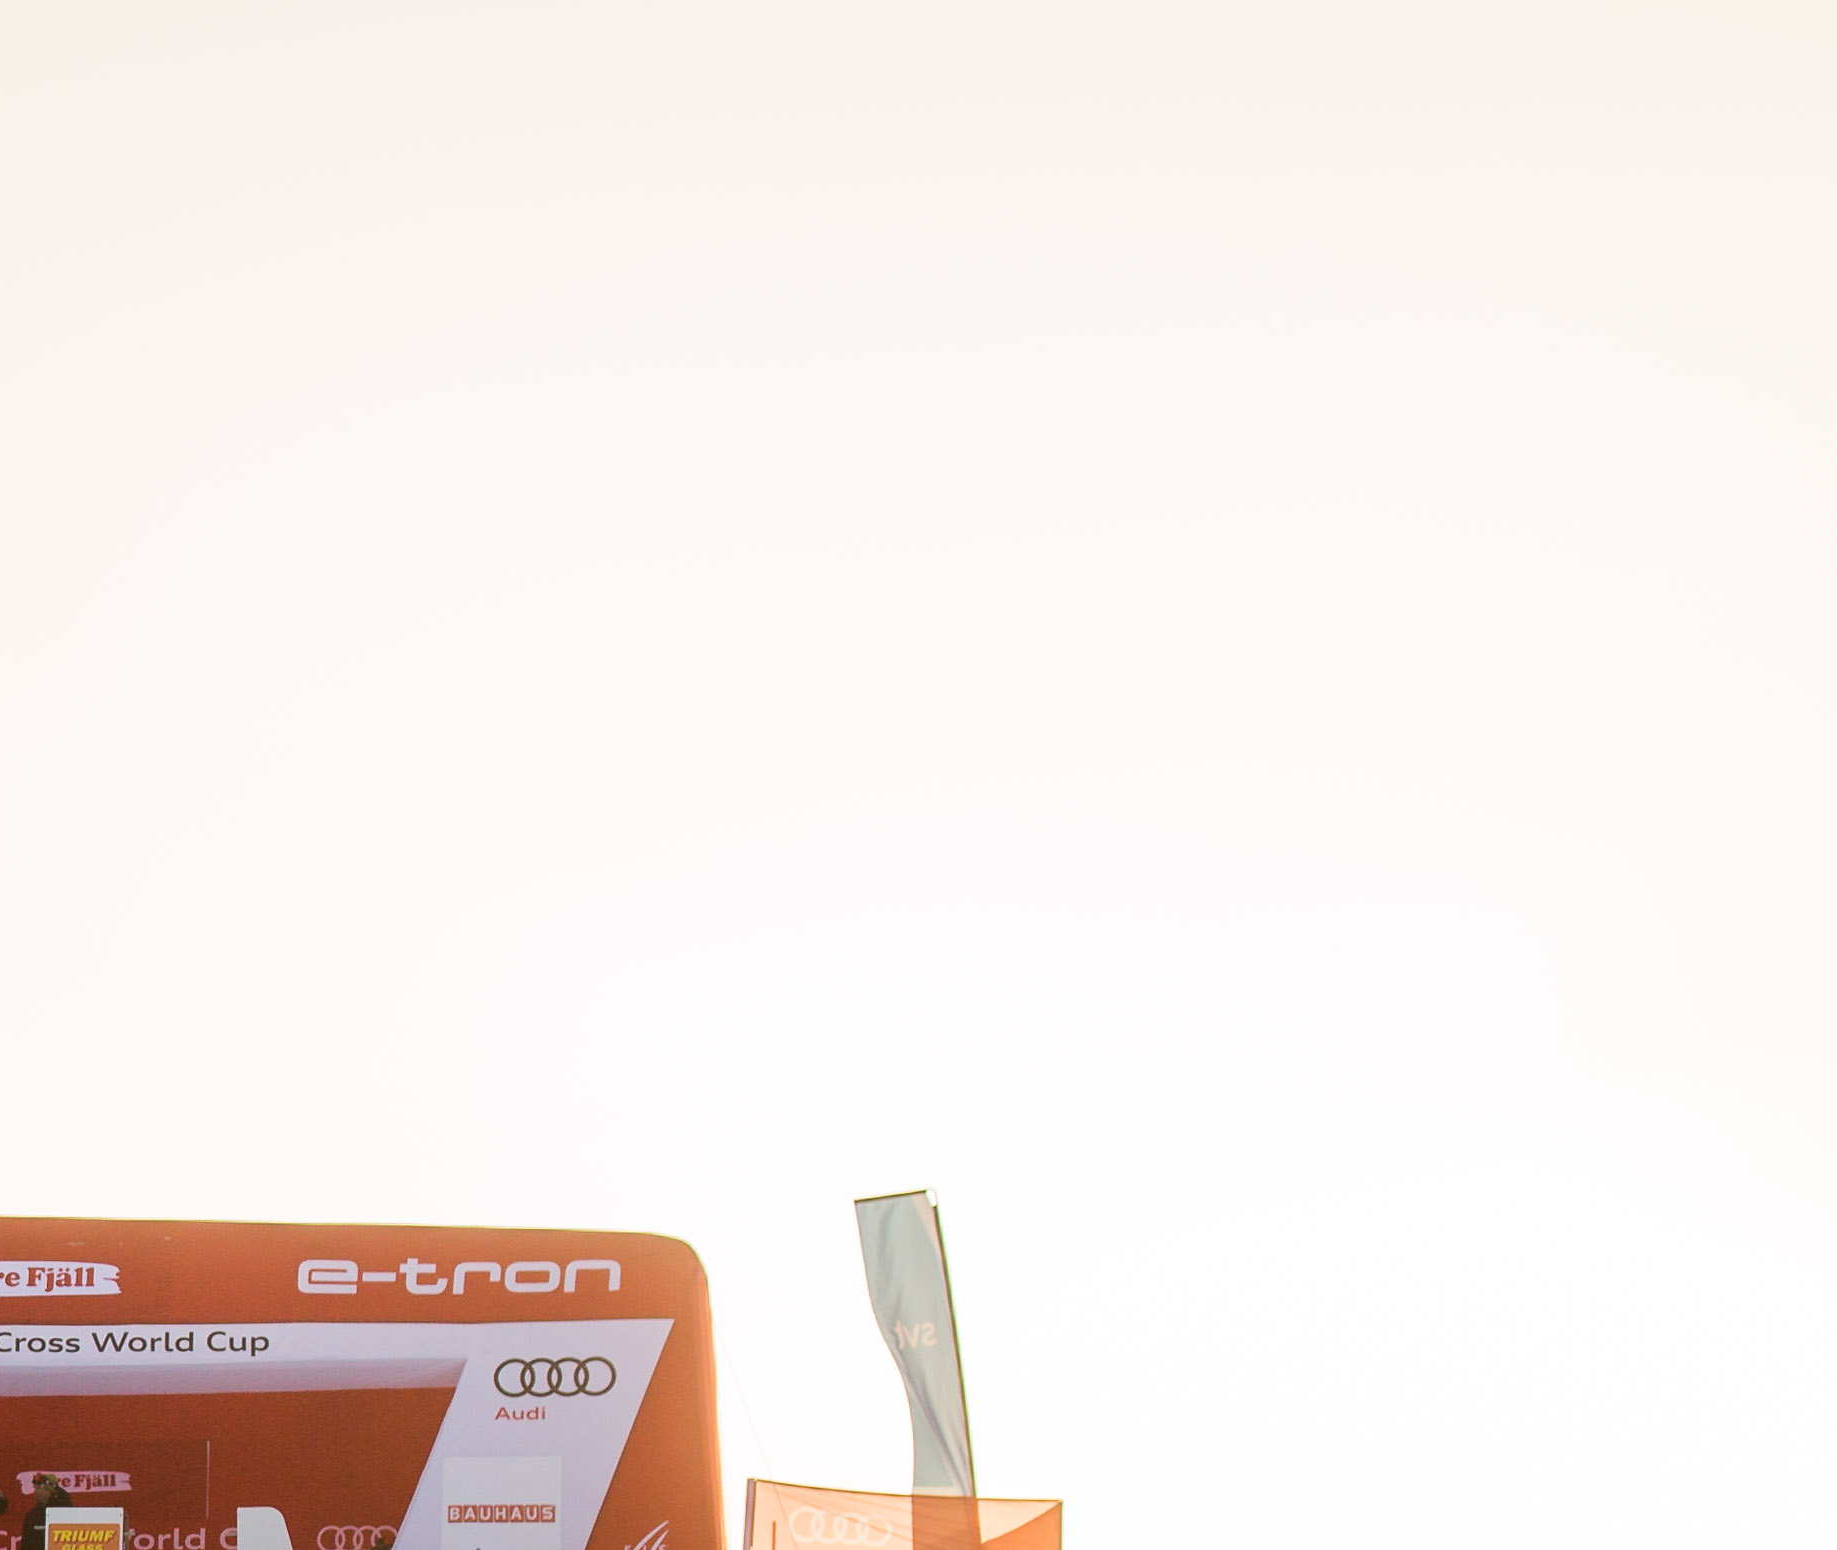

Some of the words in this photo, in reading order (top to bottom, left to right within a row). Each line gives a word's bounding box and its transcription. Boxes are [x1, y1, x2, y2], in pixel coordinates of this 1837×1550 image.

[26, 1266, 95, 1293] Fjäll
[297, 1257, 622, 1295] e-tron
[91, 1331, 195, 1353] World
[206, 1330, 270, 1357] Cup
[494, 1405, 547, 1421] Audi
[74, 1474, 116, 1490] Fjäll
[448, 1505, 555, 1522] BAUHAUS
[53, 1529, 115, 1542] TRIUMF
[125, 1528, 207, 1550] orld
